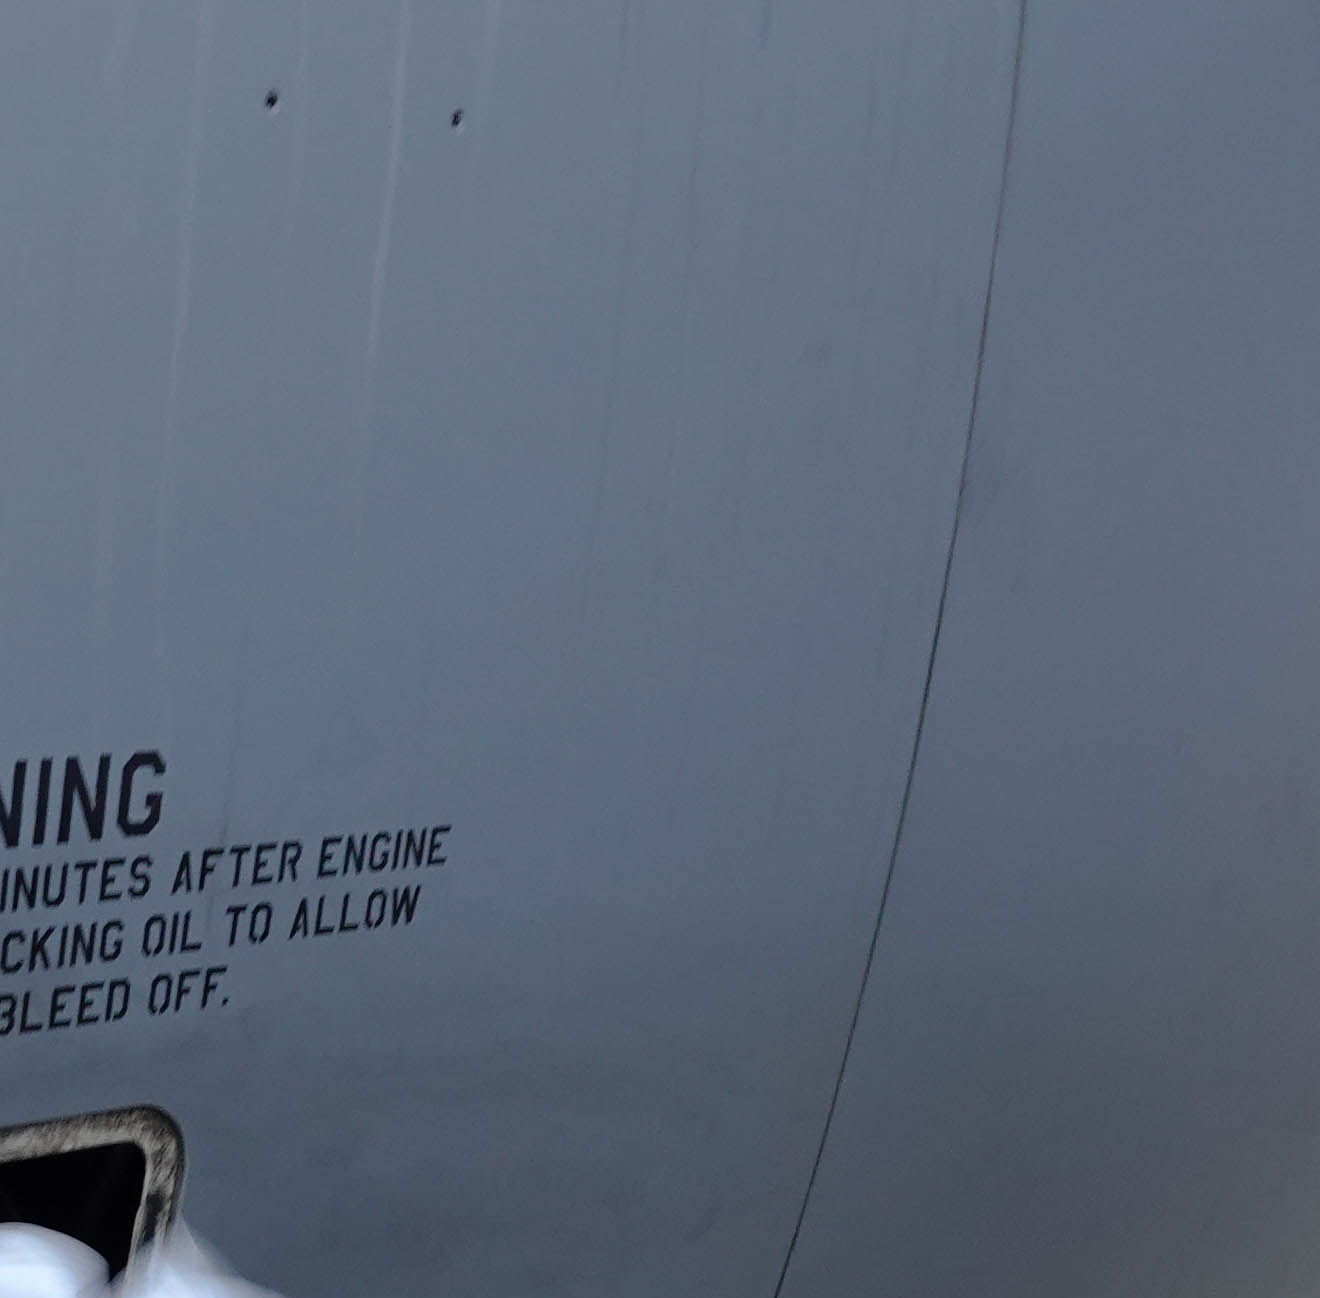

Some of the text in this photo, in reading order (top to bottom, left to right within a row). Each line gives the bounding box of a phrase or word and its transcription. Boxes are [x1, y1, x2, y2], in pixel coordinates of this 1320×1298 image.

[171, 840, 304, 895] AFTER
[316, 825, 452, 880] ENGINE
[140, 910, 203, 958] OIL
[225, 901, 273, 948] TO
[288, 884, 422, 940] ALLOW
[147, 965, 229, 1016] OFF.
